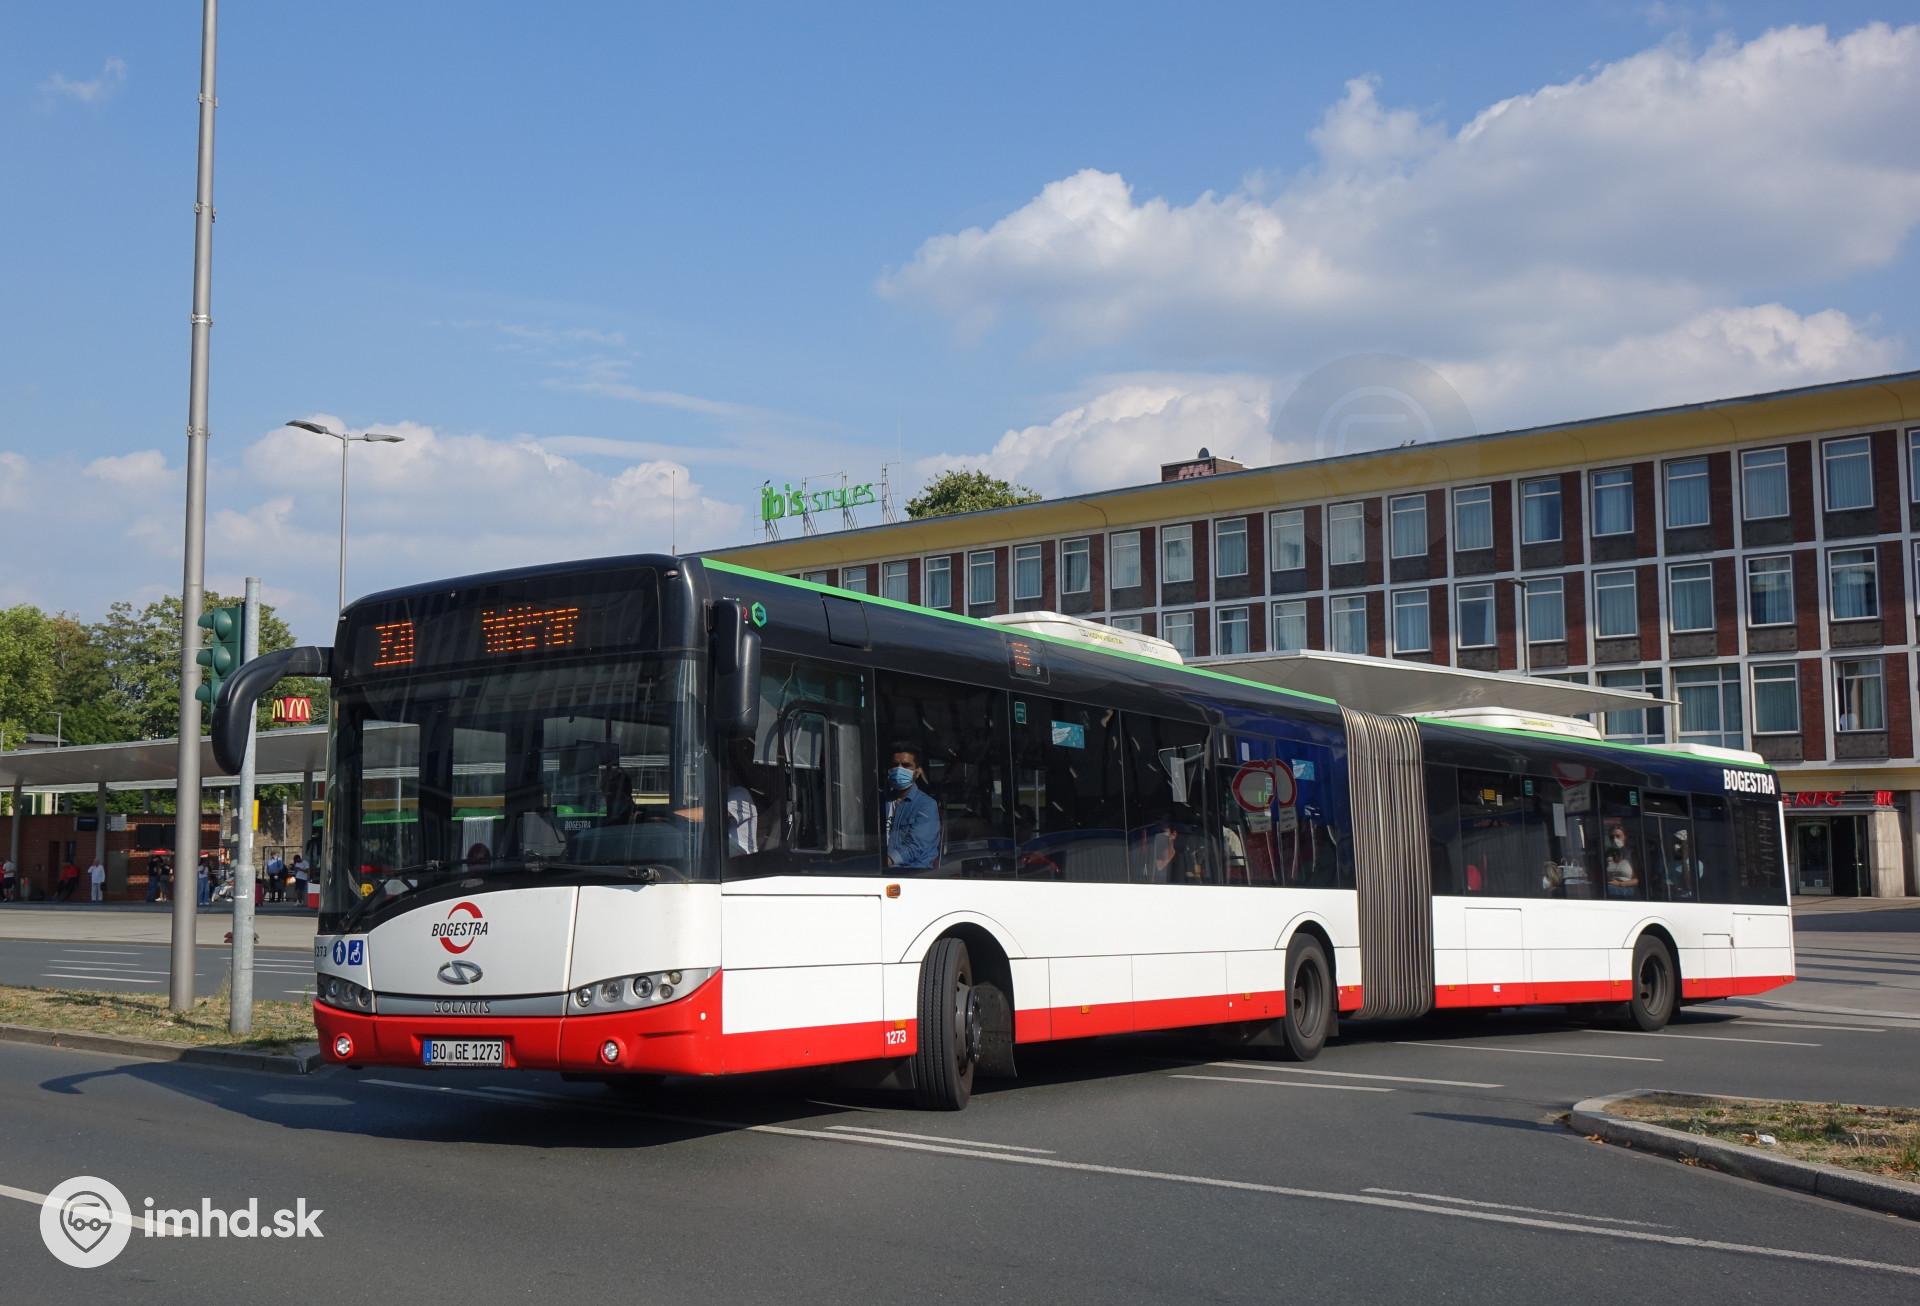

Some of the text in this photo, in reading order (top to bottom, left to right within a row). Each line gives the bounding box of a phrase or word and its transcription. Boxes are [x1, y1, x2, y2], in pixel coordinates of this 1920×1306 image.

[761, 484, 806, 520] ibis
[1723, 769, 1776, 794] BOGESTRA
[431, 922, 489, 937] BOGESTRA
[433, 1001, 491, 1014] SOLARIS
[886, 1030, 907, 1045] 1273
[432, 1043, 501, 1060] BO GE 1273
